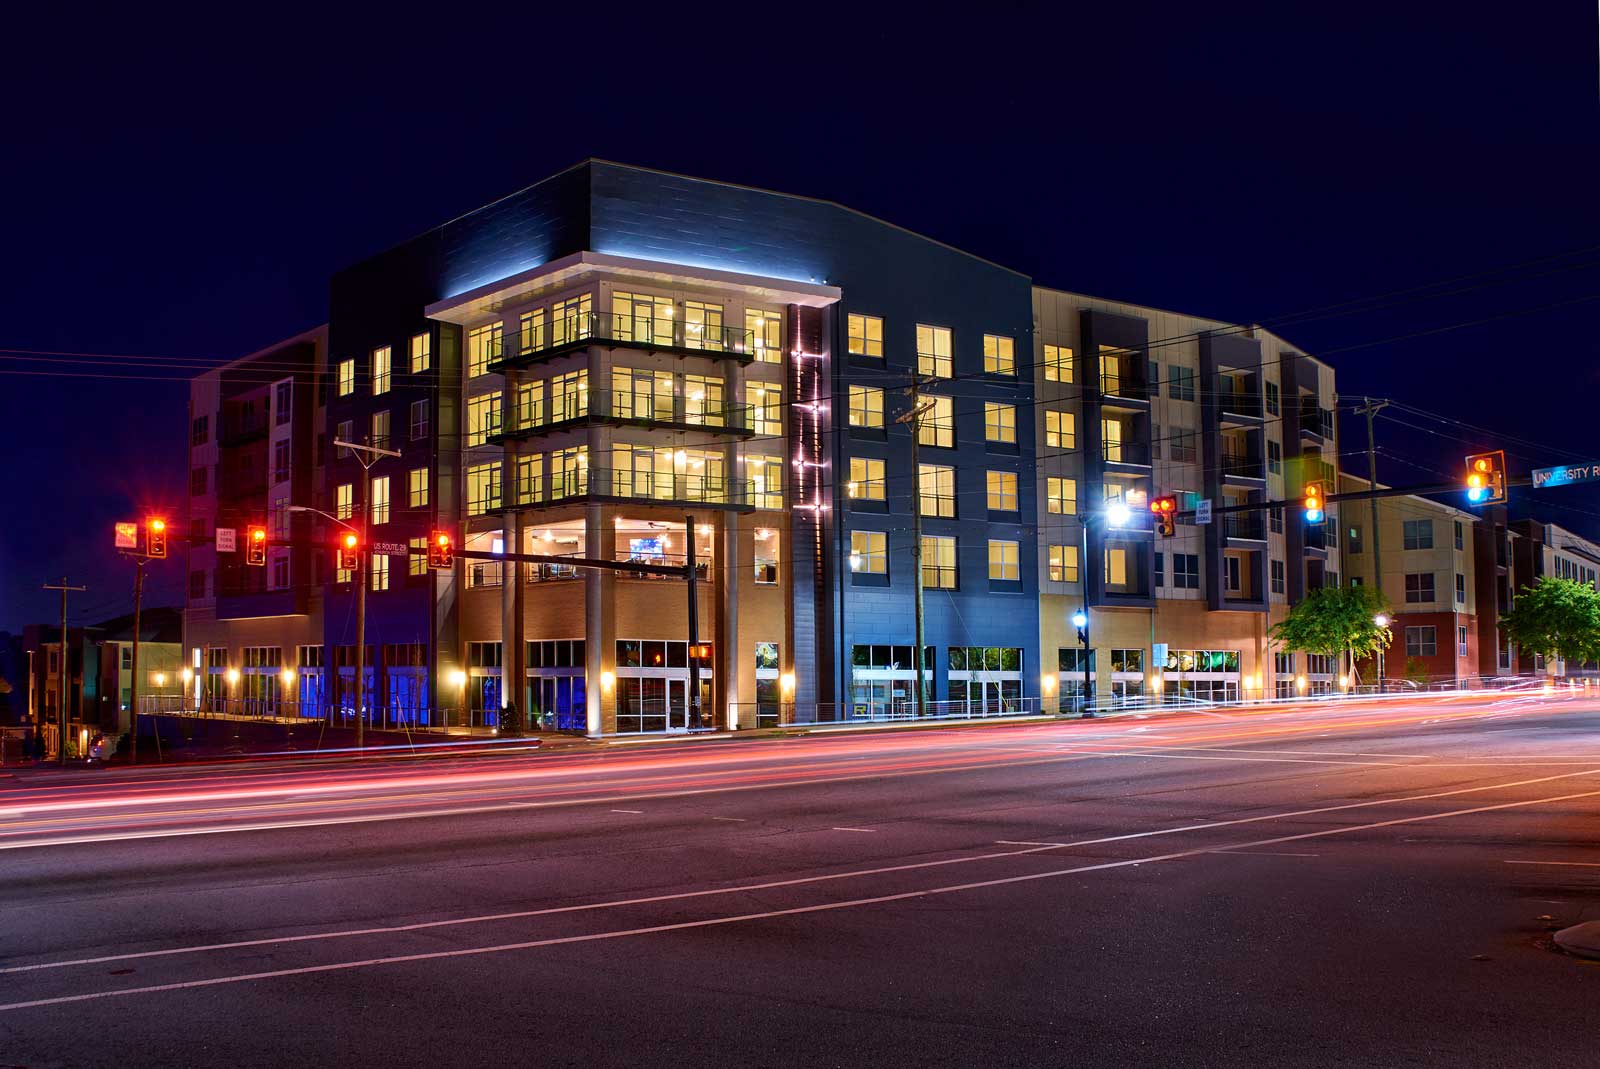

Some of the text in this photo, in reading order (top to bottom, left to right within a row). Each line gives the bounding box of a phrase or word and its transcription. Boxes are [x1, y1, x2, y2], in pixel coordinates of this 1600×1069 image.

[1534, 465, 1600, 484] UNIVERSITY R
[381, 543, 399, 551] ROUTE
